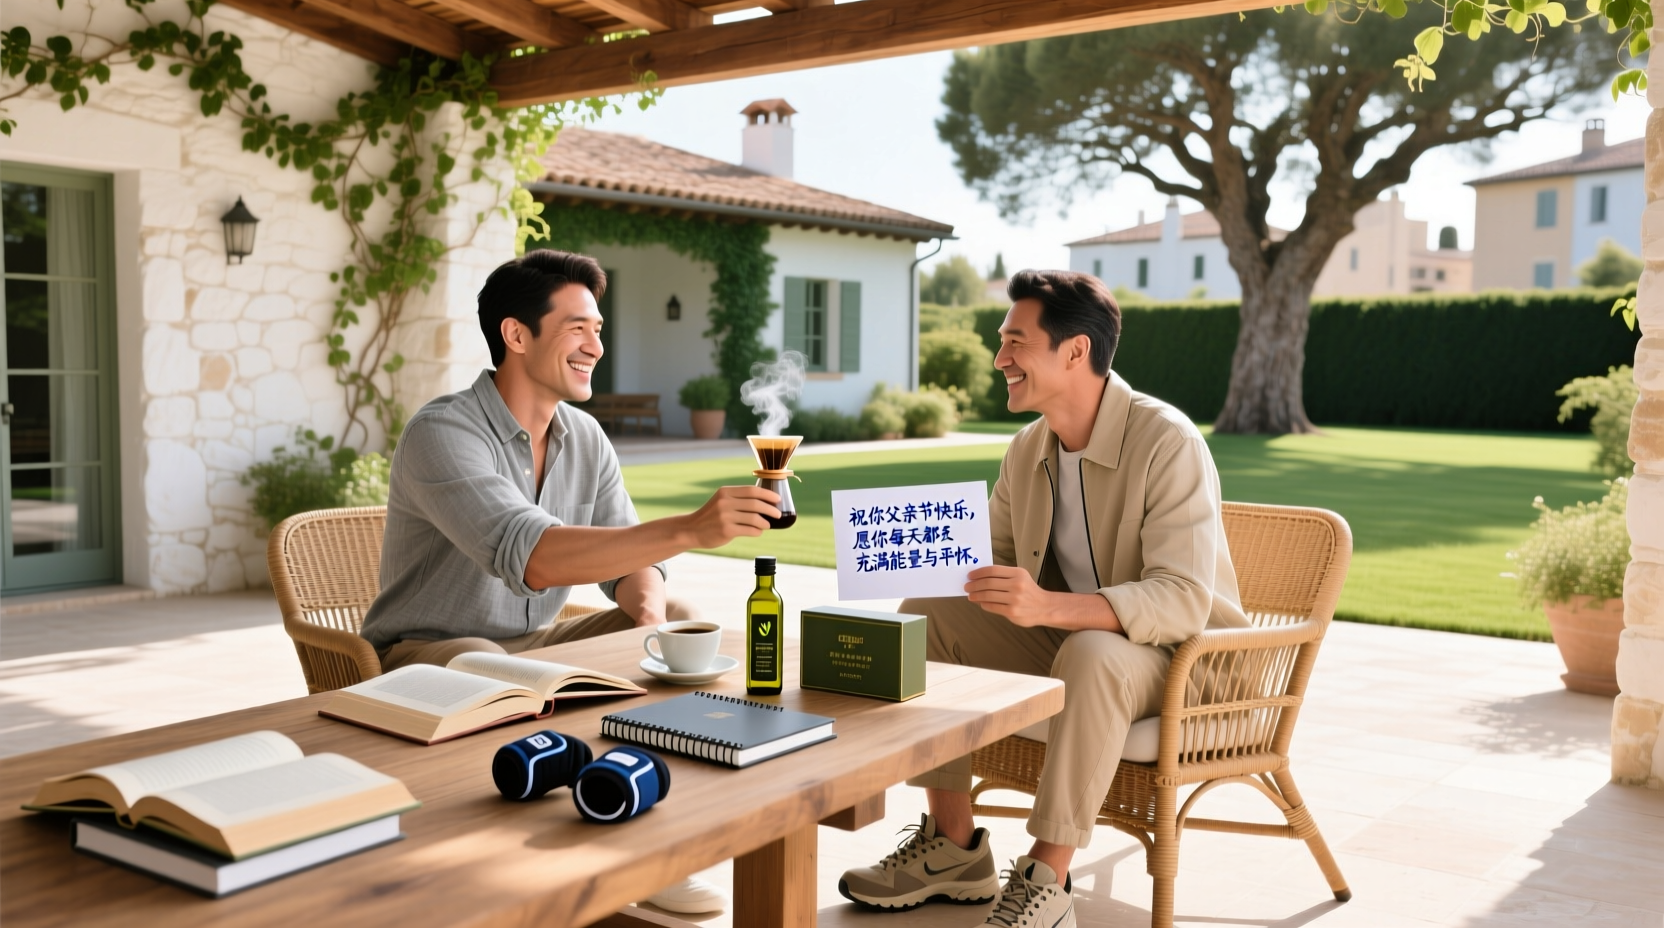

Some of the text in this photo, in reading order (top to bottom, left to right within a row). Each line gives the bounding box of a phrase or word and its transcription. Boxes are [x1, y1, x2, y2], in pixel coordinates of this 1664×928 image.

[849, 499, 975, 527] 祝你父亲节快乐,
